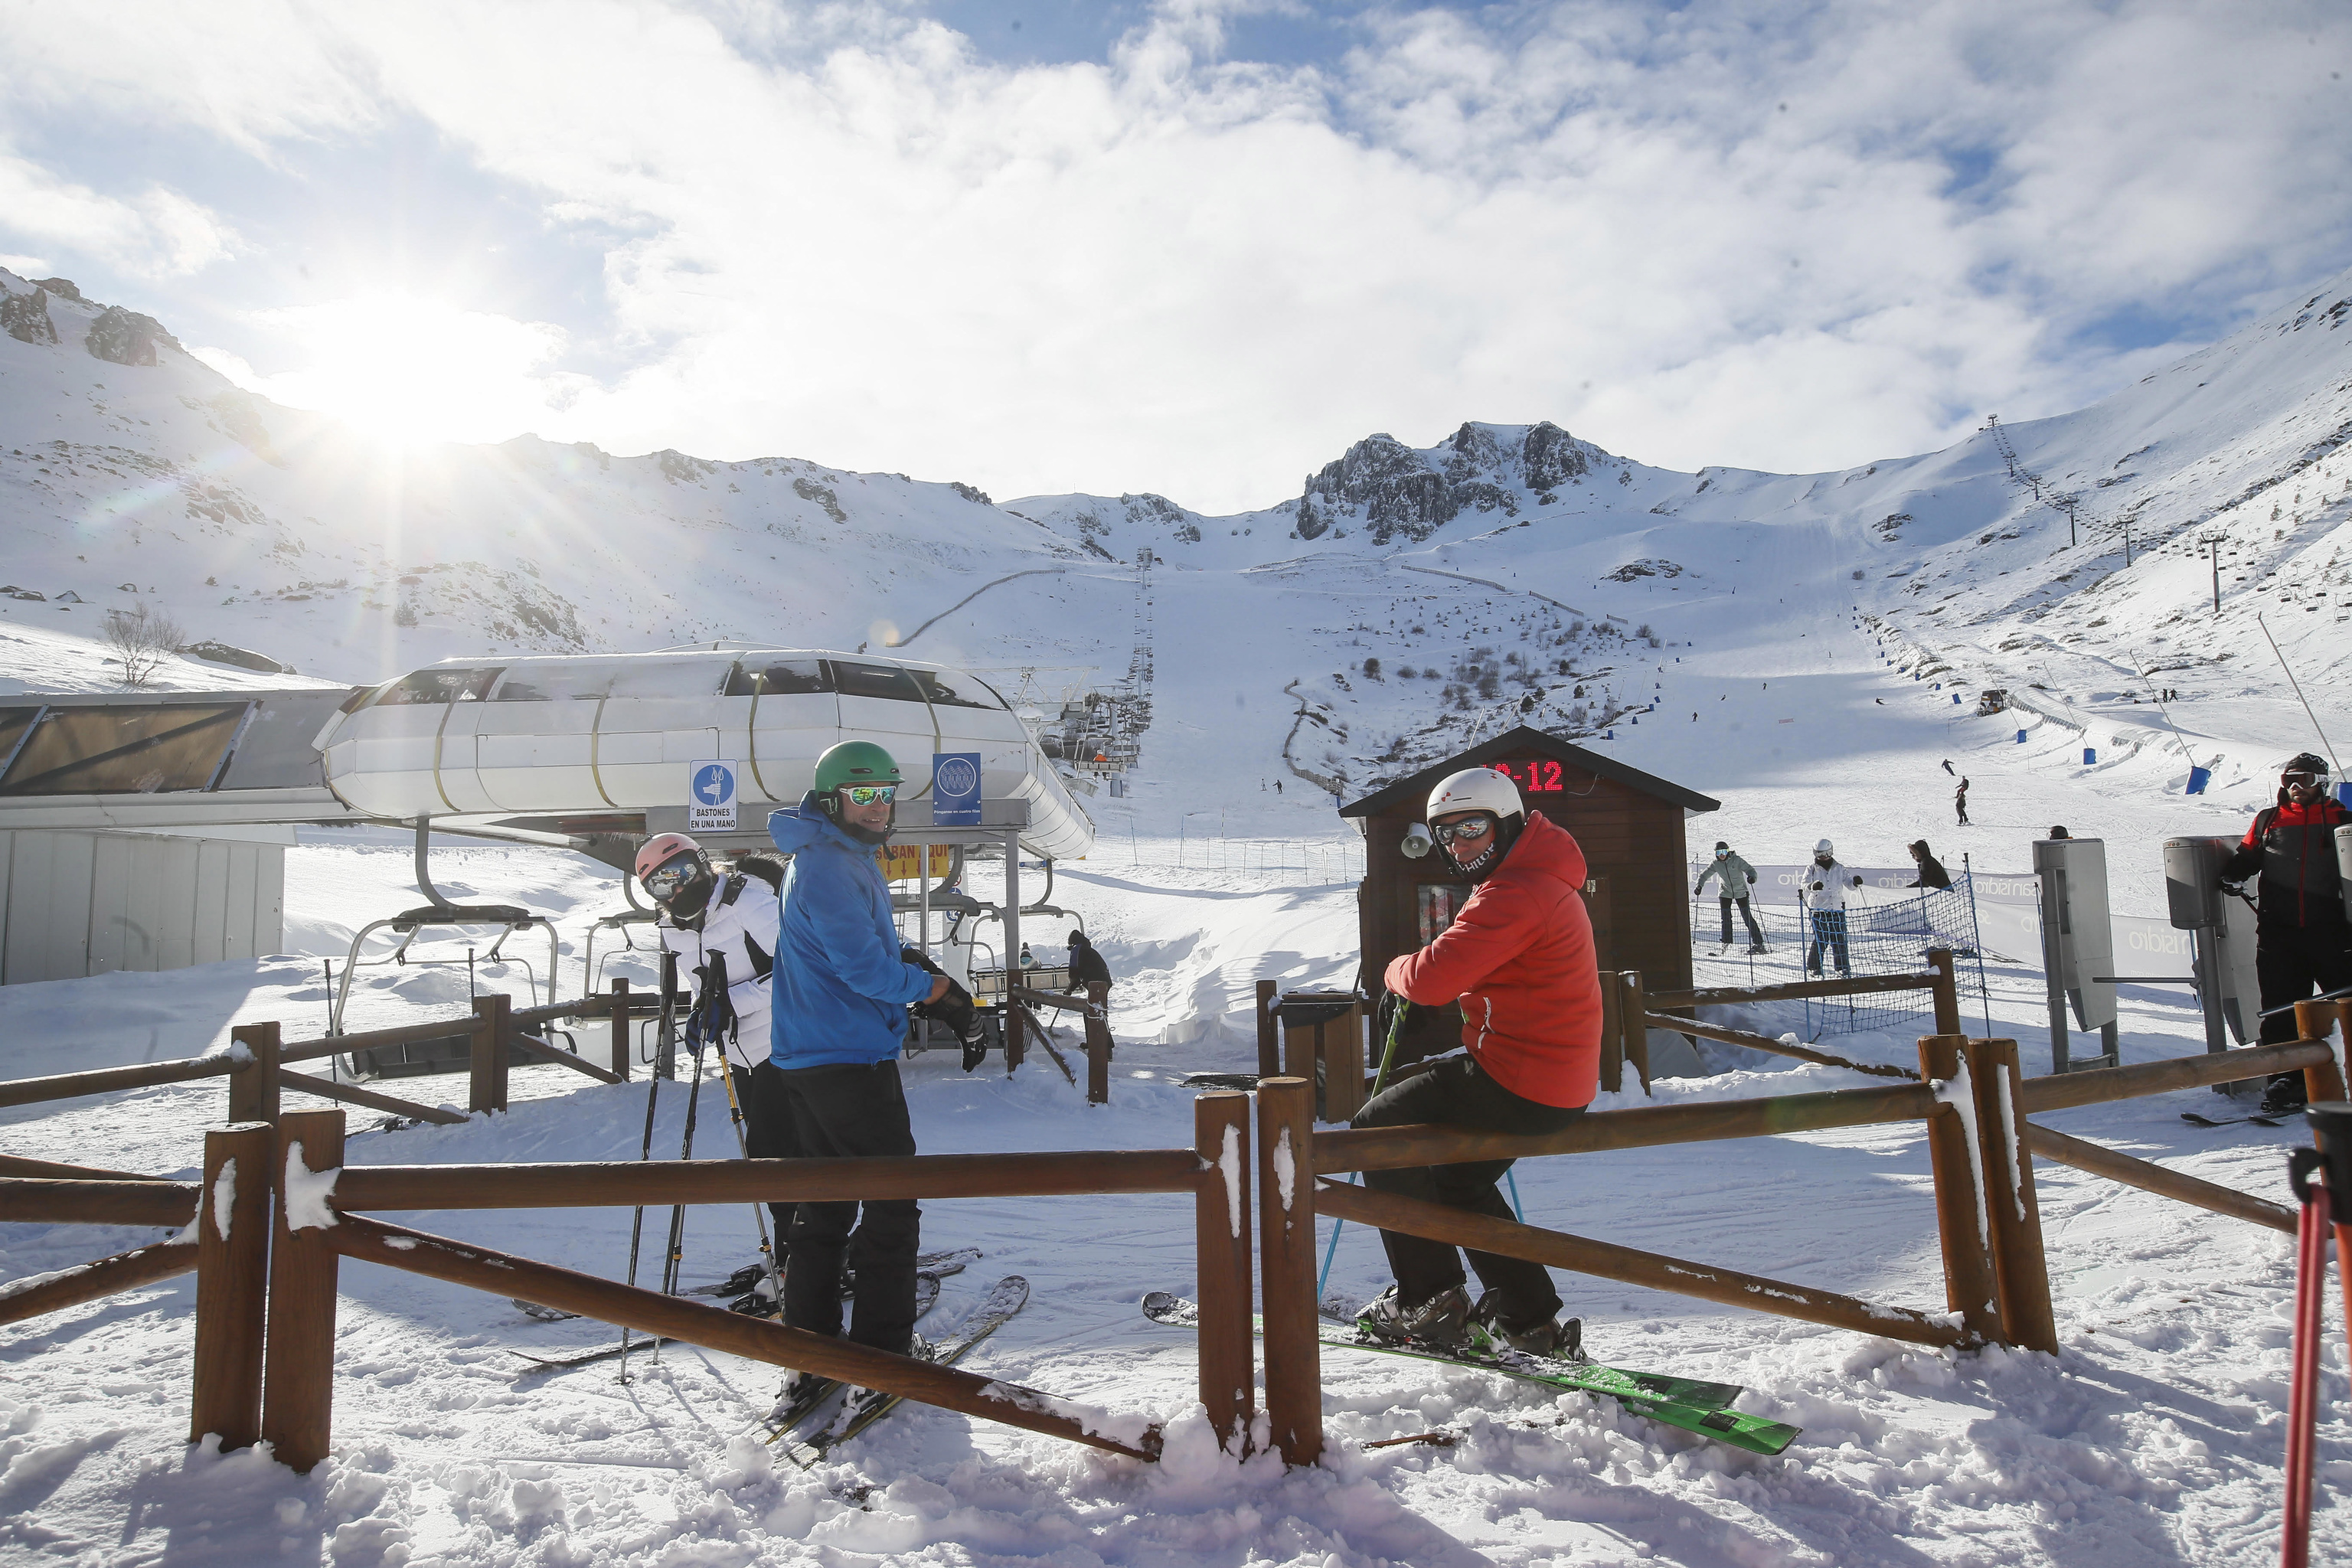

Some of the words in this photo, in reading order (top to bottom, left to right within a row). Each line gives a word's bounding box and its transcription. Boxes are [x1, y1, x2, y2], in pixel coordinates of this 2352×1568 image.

[696, 808, 730, 817] BASTONES
[691, 820, 700, 828] EN
[701, 820, 715, 828] UNA
[717, 819, 735, 828] MANO
